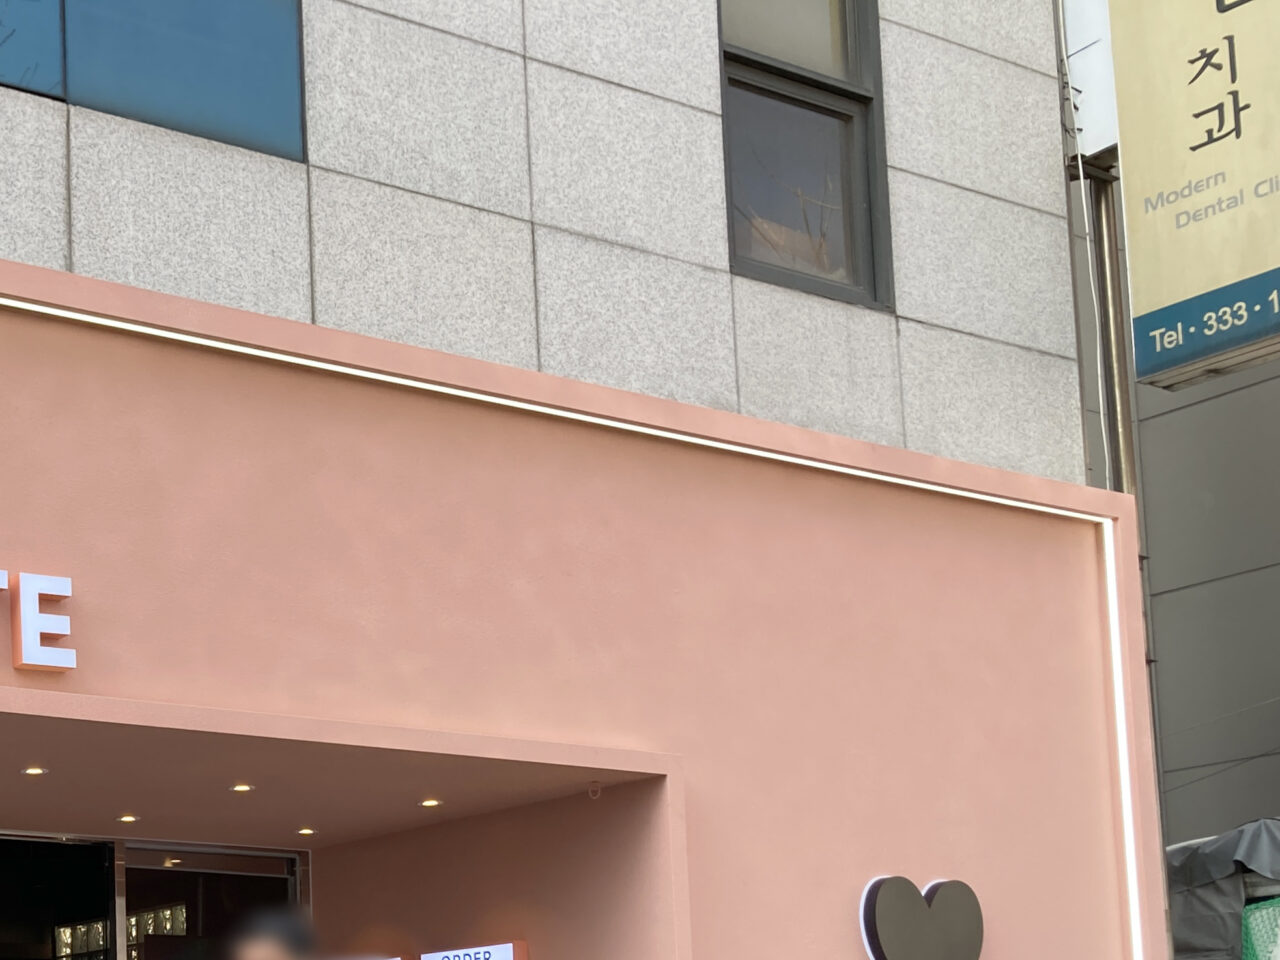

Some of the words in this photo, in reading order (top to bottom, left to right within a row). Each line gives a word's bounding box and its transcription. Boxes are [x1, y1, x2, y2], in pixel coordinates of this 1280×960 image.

[1186, 34, 1252, 153] 치과
[1143, 171, 1227, 214] Modern
[1175, 188, 1245, 230] Dental
